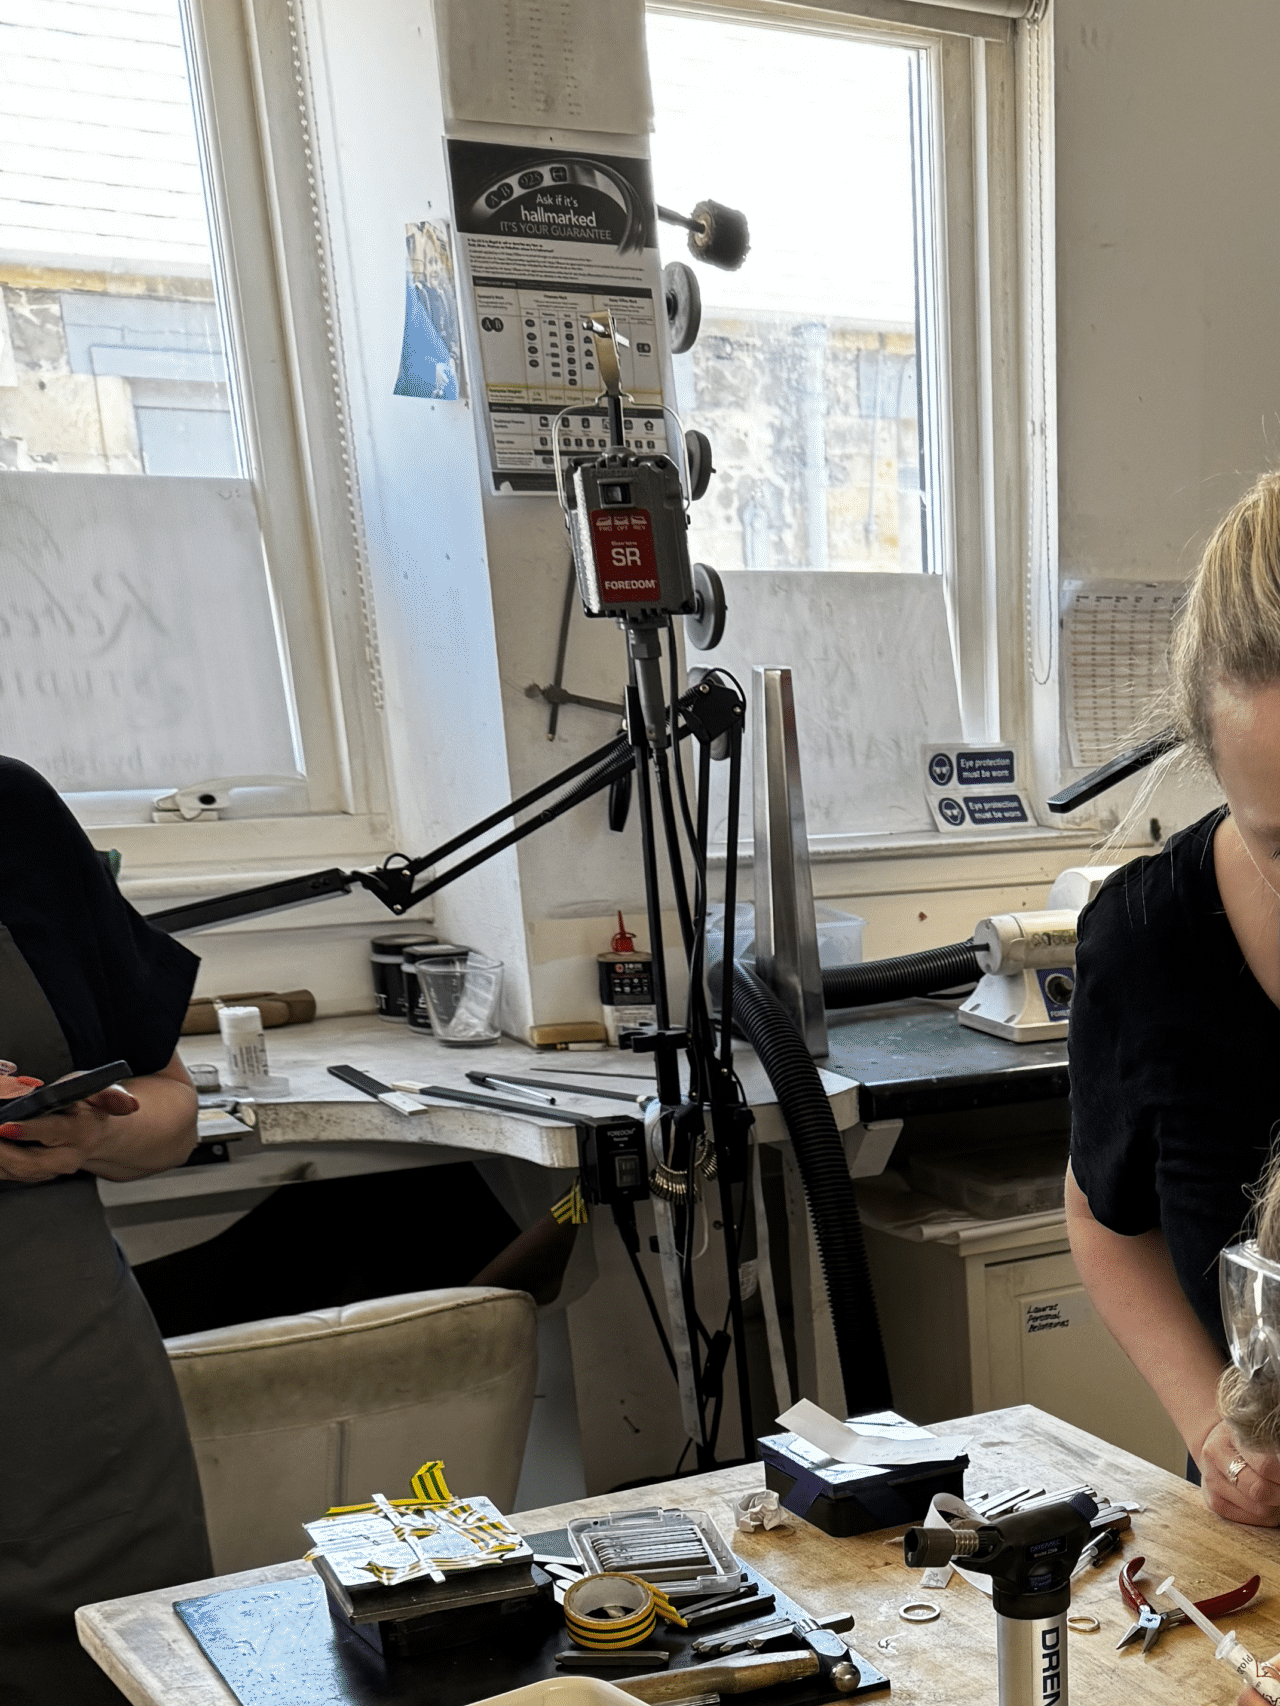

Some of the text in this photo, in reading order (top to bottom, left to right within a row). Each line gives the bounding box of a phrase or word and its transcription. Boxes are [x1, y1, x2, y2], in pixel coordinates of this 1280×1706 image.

[536, 193, 578, 207] Ask if it's
[520, 205, 597, 227] hallmarked
[500, 221, 612, 240] IT'S YOUR GUARANTEE
[611, 547, 641, 566] SR
[604, 579, 656, 590] FOREDOM
[961, 758, 1010, 768] Eye protection
[969, 801, 1019, 810] Eye protection
